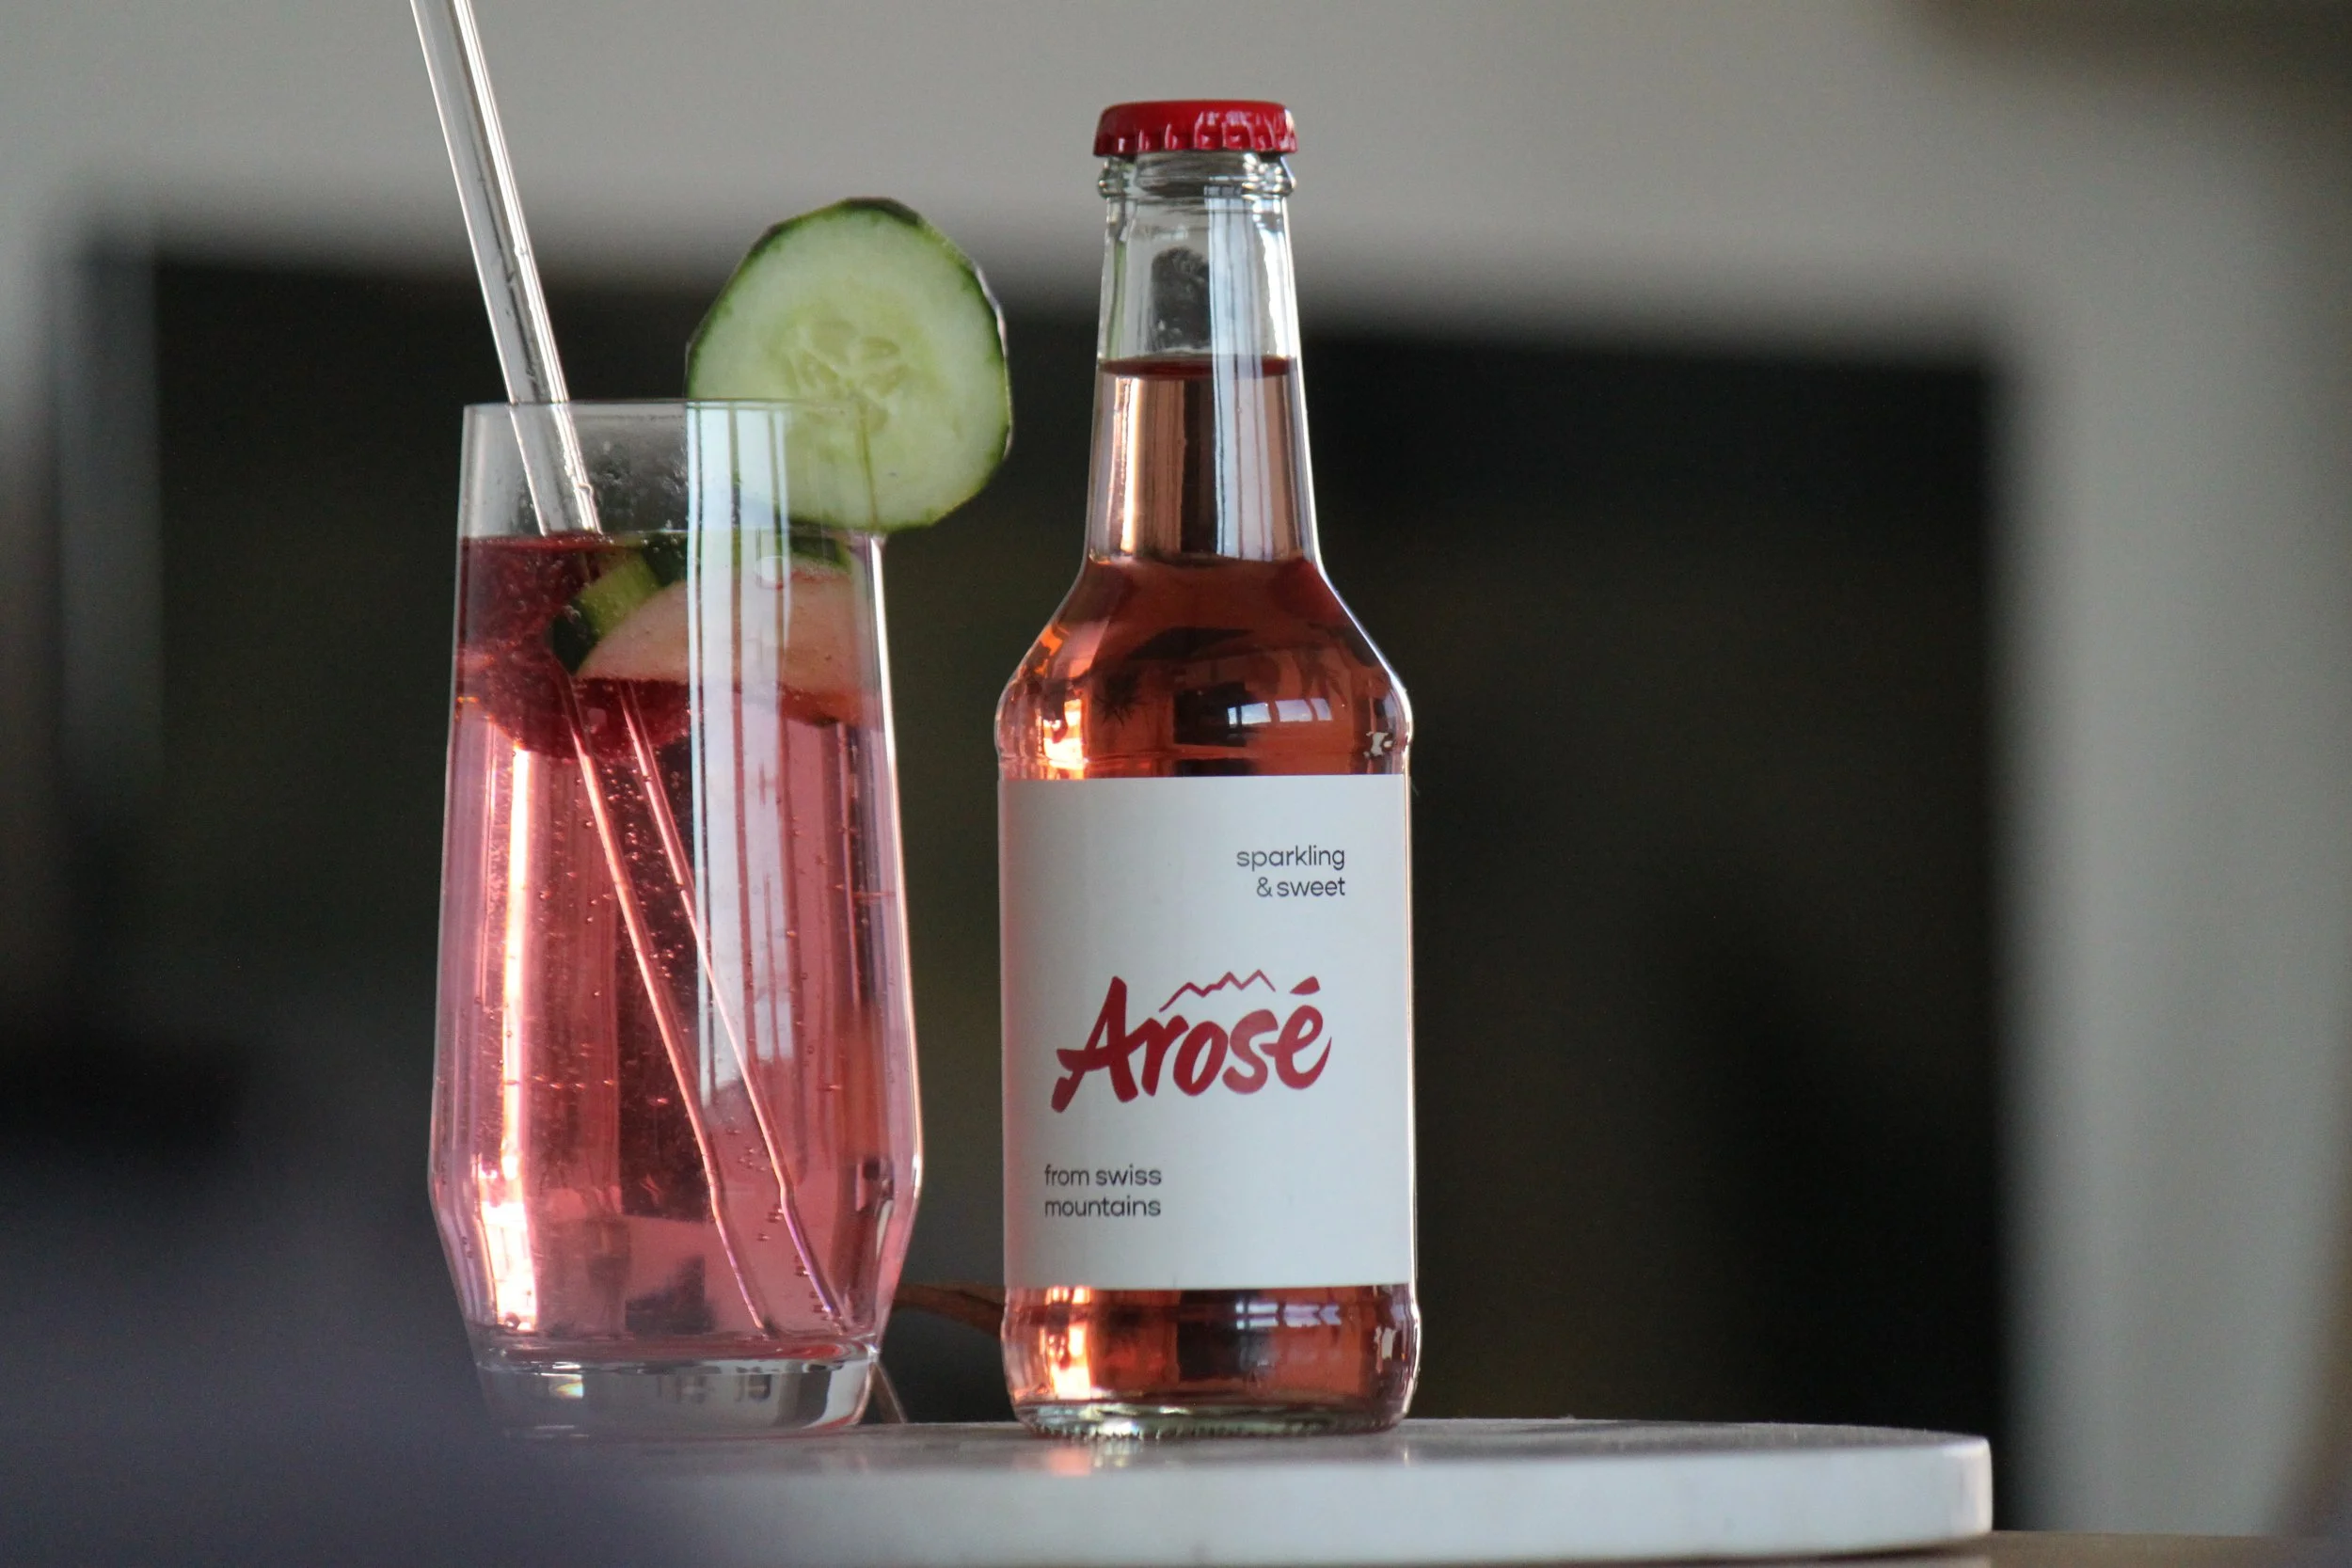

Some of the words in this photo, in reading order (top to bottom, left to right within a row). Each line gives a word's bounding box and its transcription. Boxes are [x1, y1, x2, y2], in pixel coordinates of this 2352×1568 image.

[1236, 844, 1345, 872] sparkling
[1256, 876, 1273, 897] &
[1277, 876, 1346, 897] sweet
[1051, 974, 1332, 1113] Arosé
[1044, 1164, 1089, 1186] from
[1095, 1164, 1163, 1186] swiss
[1044, 1195, 1162, 1217] mountains
